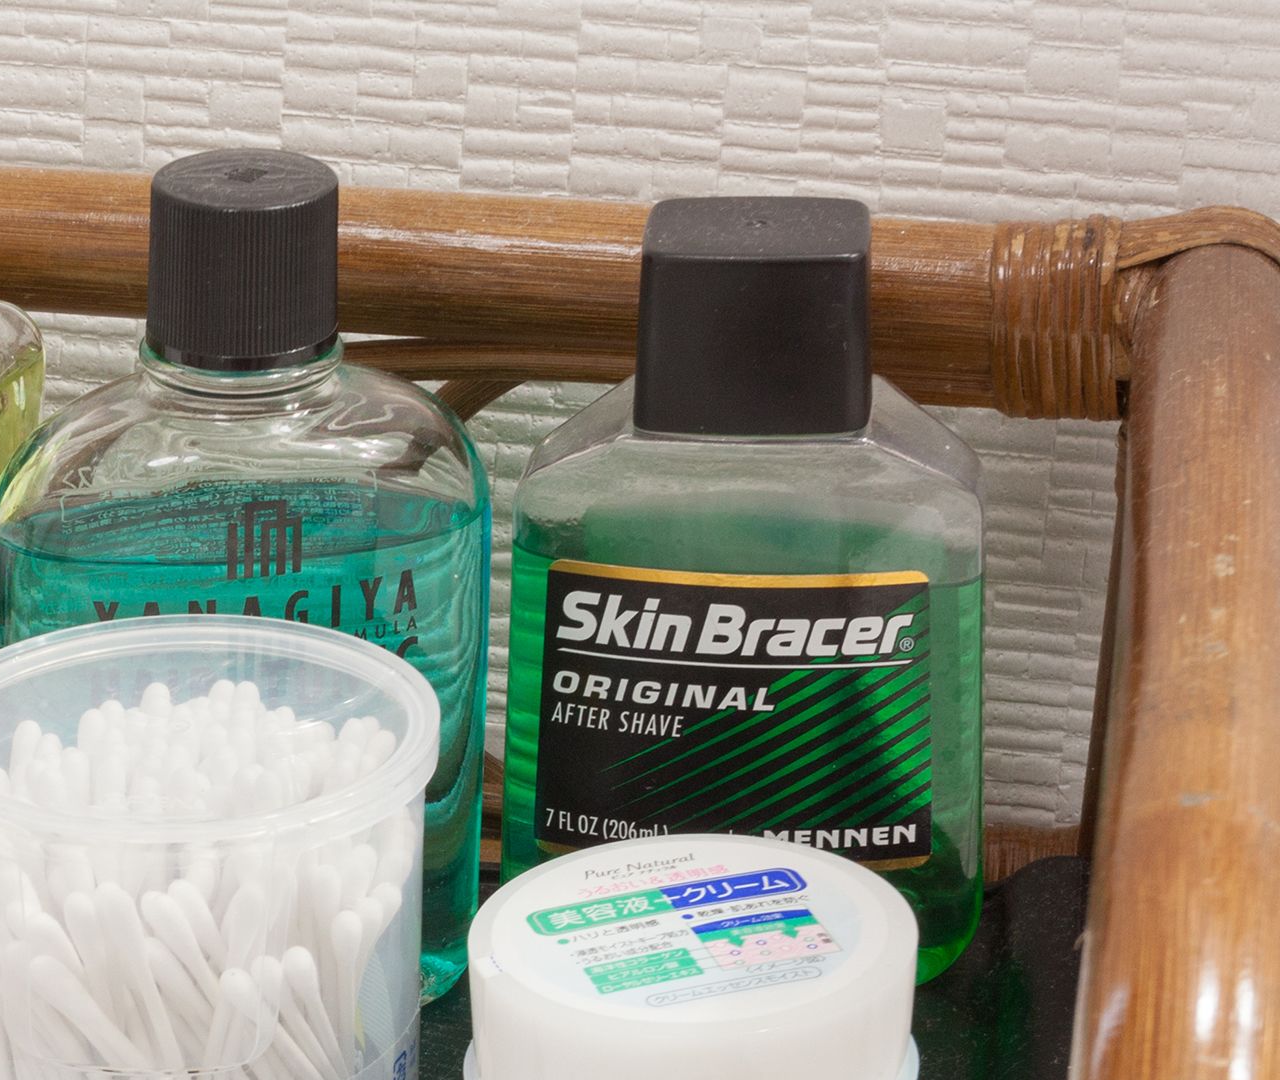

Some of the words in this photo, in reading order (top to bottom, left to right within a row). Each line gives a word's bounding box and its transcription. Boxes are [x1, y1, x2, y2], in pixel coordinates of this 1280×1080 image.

[556, 590, 692, 654] Skin
[695, 603, 914, 658] Bracer
[552, 670, 776, 711] ORIGINAL
[551, 702, 610, 731] AFTER
[618, 711, 684, 738] SHAVE
[546, 808, 555, 827] 7
[559, 811, 575, 831] FL
[578, 815, 600, 836] OZ
[763, 823, 916, 849] MENNEN
[584, 868, 619, 880] Pure
[627, 854, 696, 872] Natural
